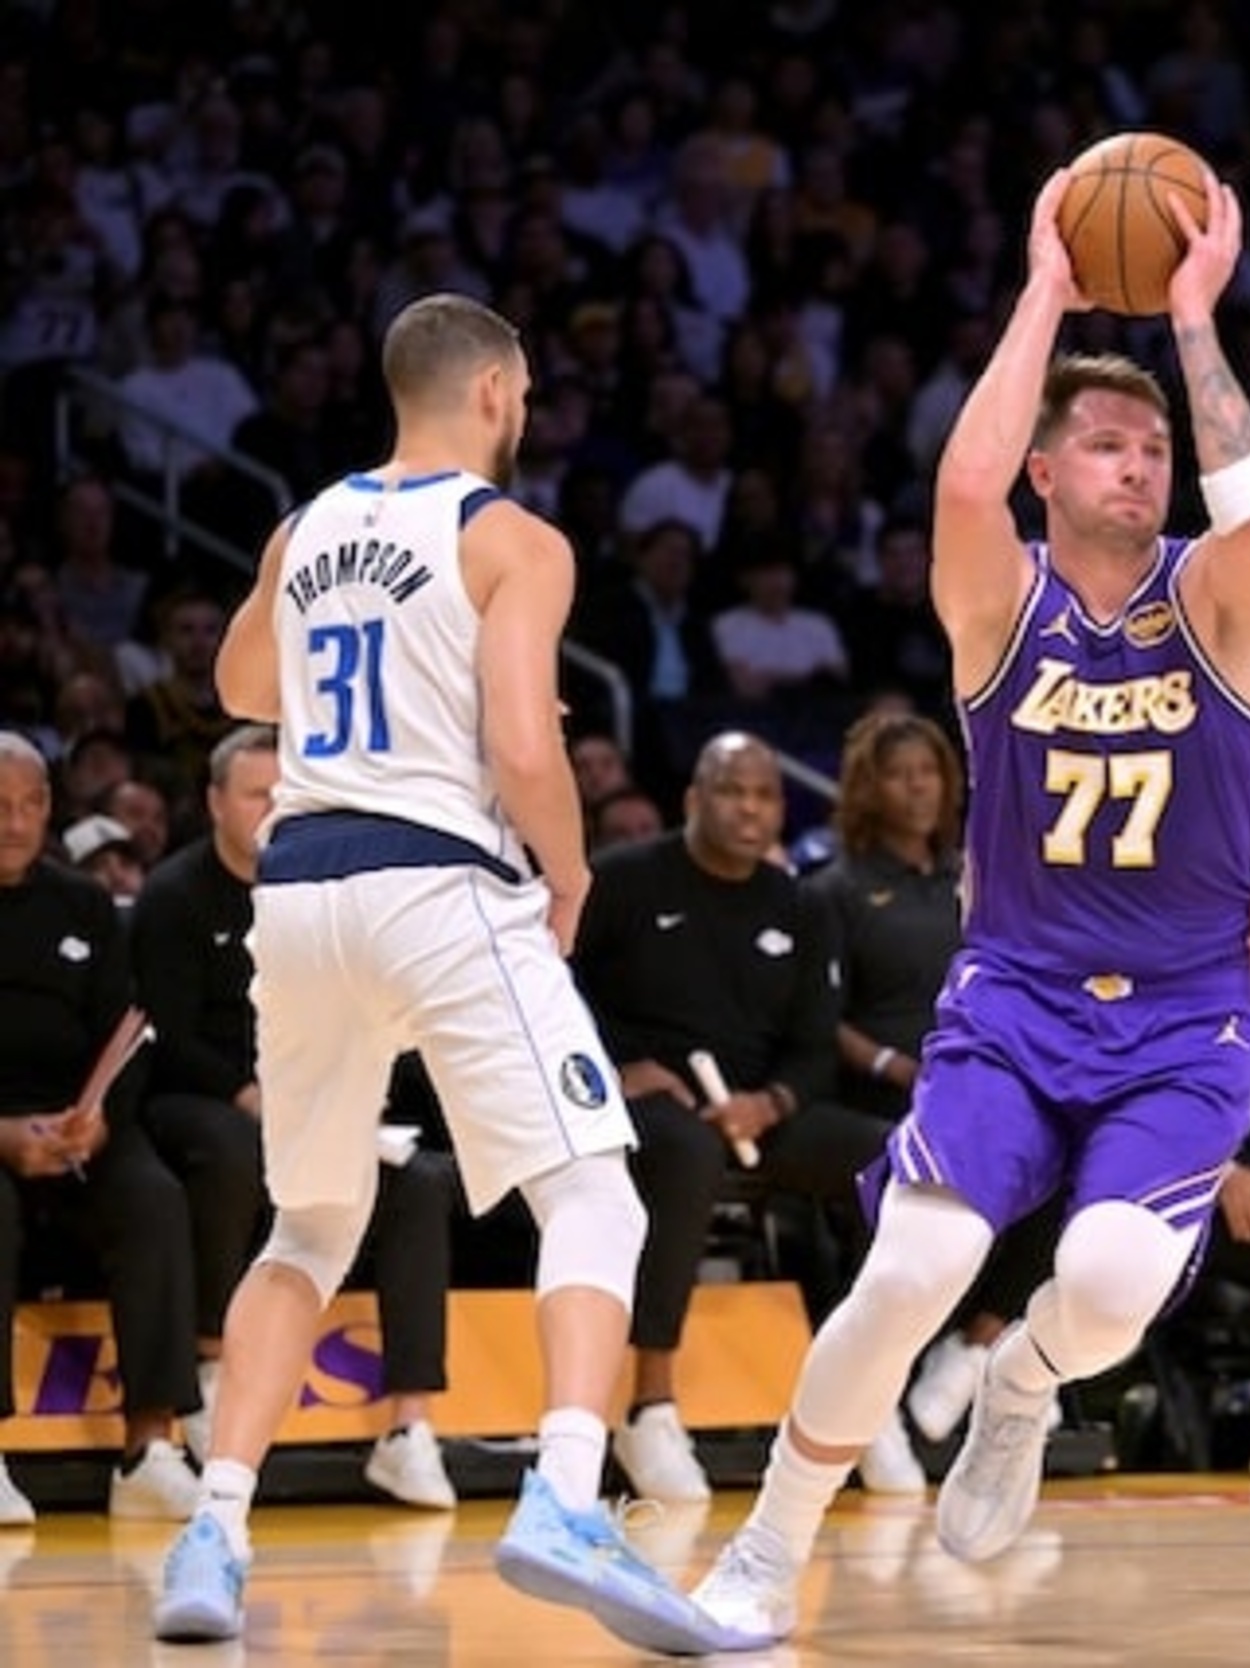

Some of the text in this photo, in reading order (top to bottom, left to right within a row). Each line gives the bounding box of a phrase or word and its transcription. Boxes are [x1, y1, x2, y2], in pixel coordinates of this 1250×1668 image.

[285, 539, 434, 615] THOMPSON
[303, 617, 392, 758] 31
[1010, 656, 1198, 737] LAKERS
[1042, 748, 1174, 869] 77
